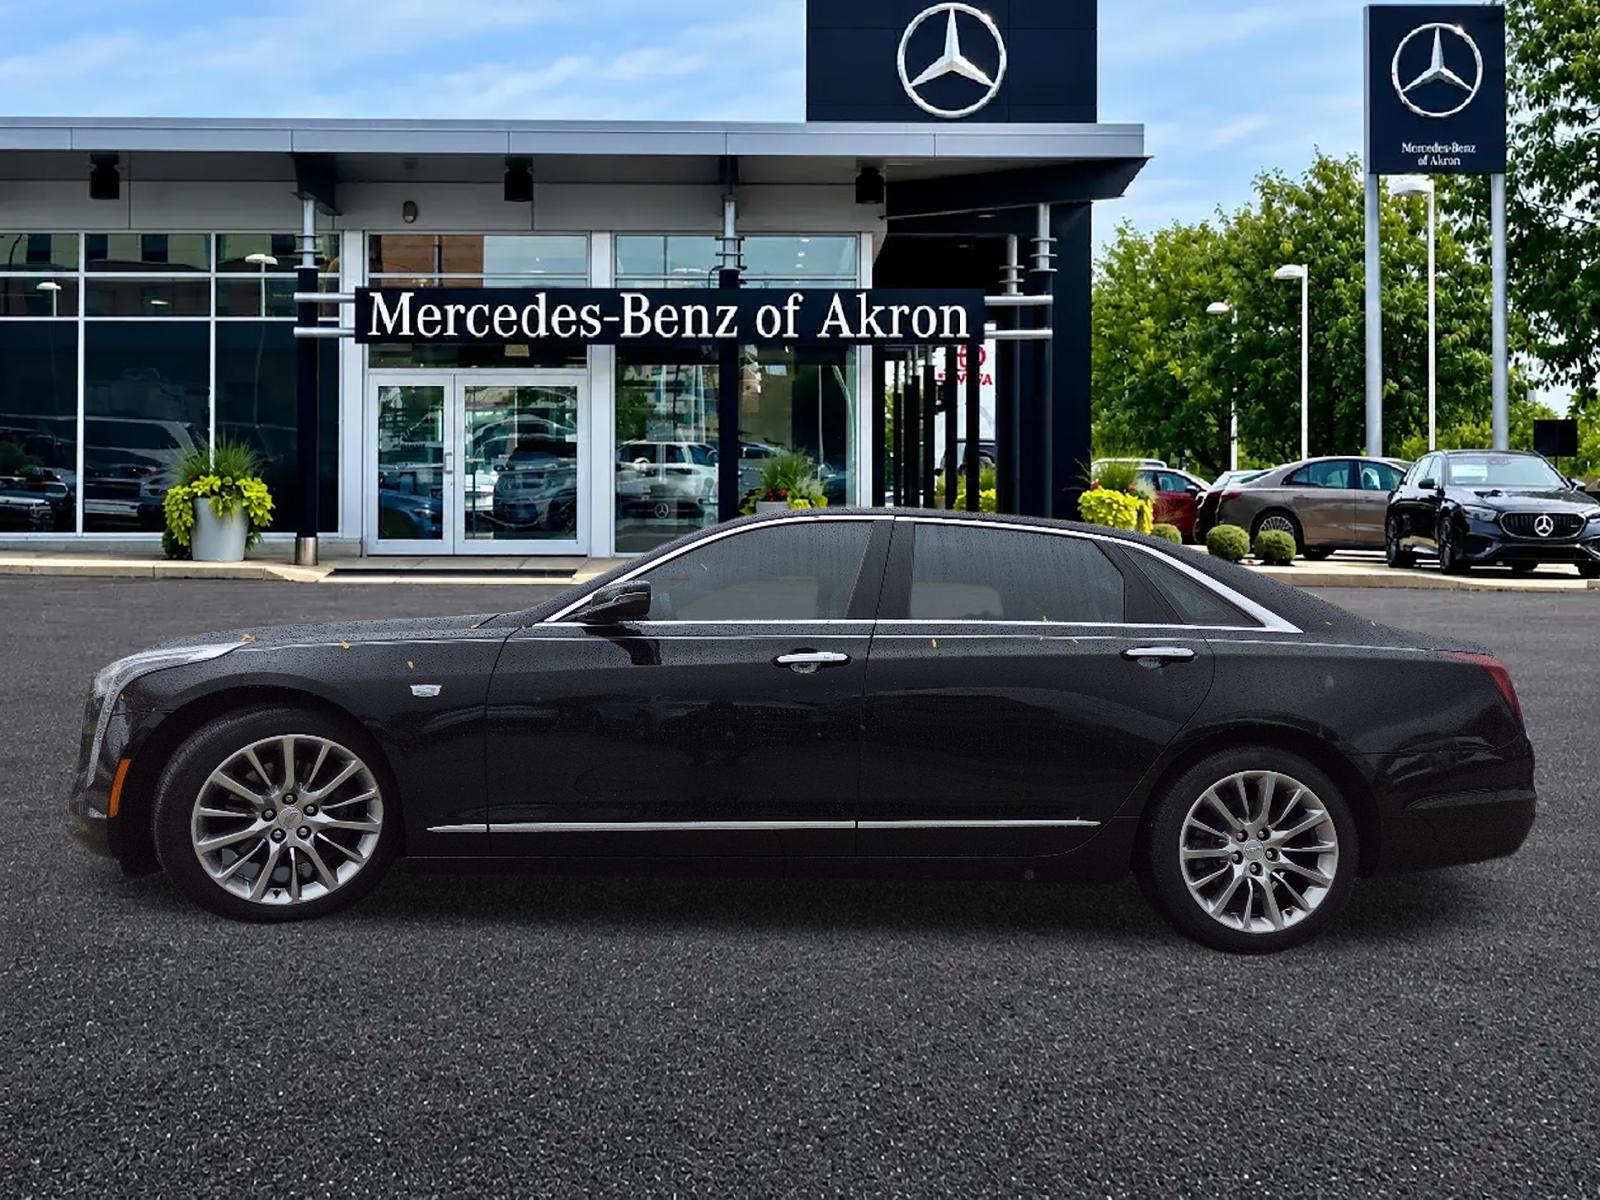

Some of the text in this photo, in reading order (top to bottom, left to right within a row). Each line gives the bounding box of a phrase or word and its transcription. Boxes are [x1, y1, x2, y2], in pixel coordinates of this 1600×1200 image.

[1401, 141, 1476, 154] Mercedes-Benz
[1417, 154, 1461, 166] of Akron
[367, 291, 970, 339] Mercedes-Benz of Akron
